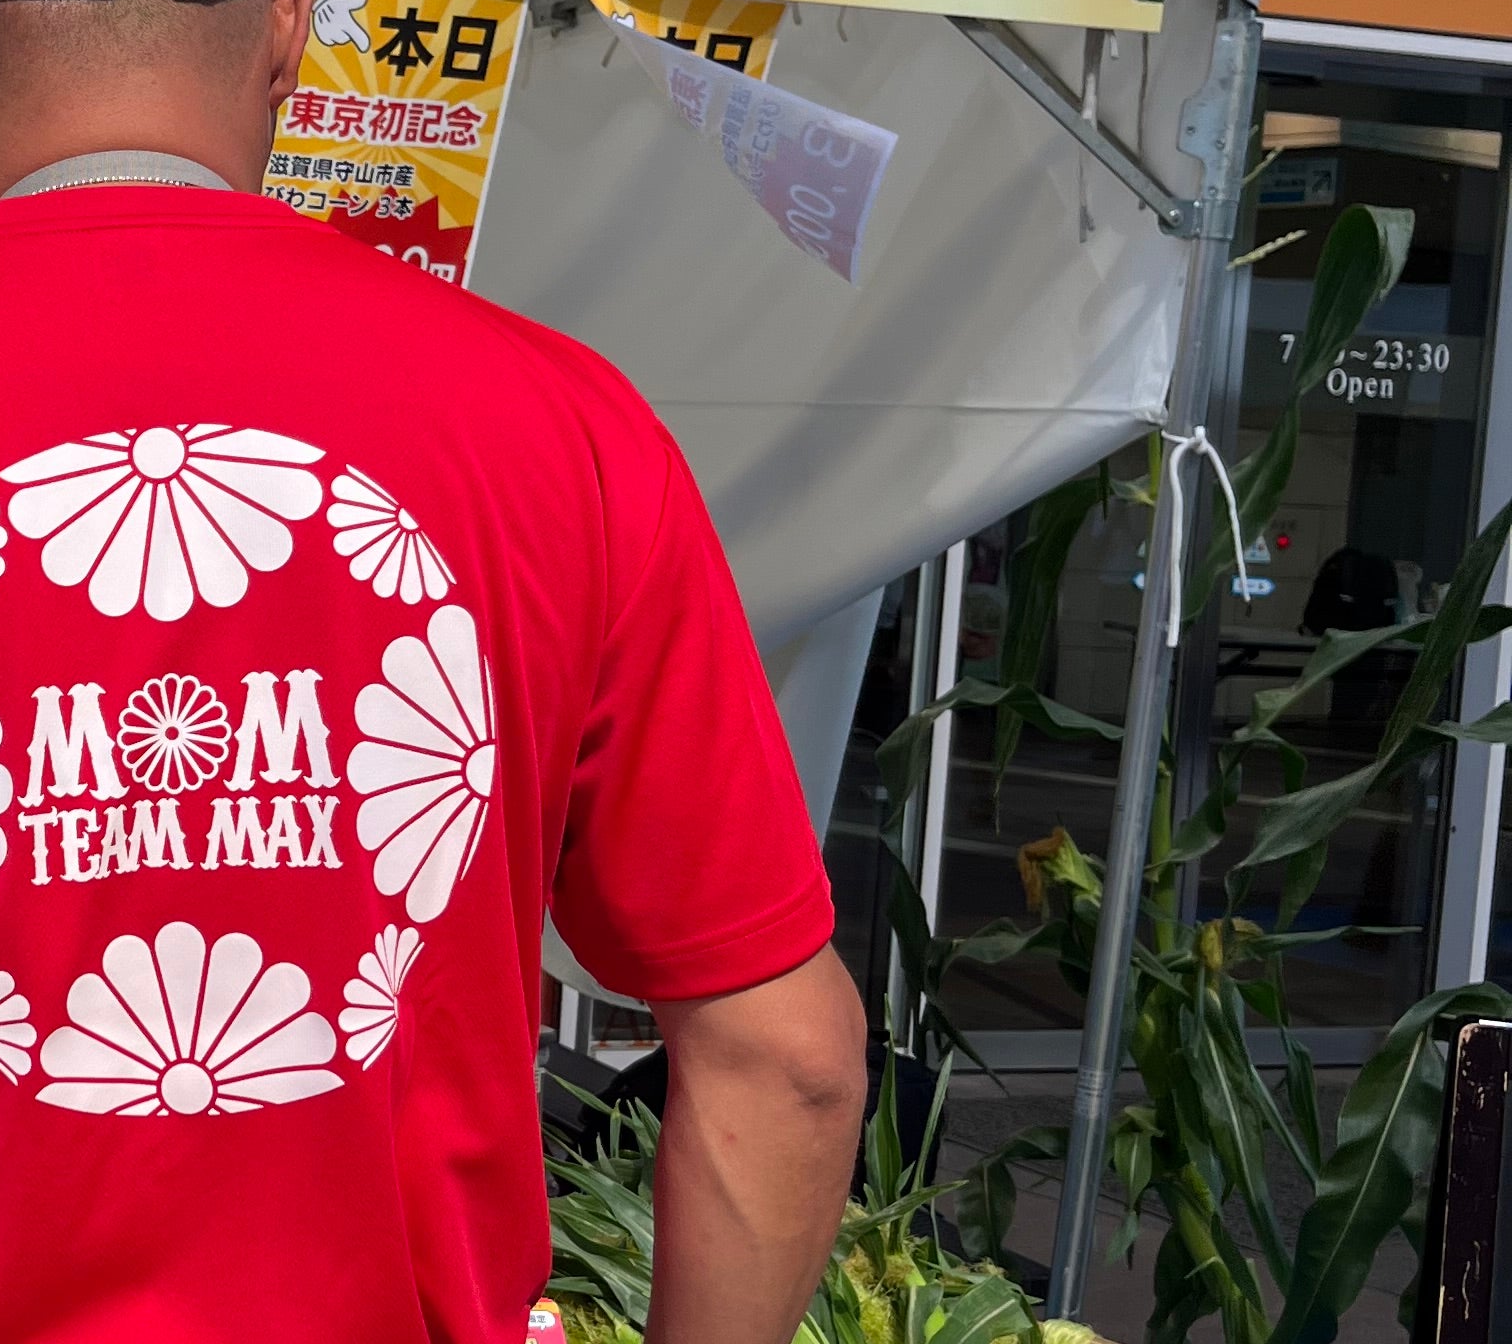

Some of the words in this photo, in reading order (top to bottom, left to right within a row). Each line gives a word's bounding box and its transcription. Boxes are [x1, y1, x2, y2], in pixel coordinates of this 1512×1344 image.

[374, 7, 498, 81] 本日
[285, 90, 482, 147] 東京初記念
[268, 154, 415, 187] 滋賀県守山市産
[1326, 367, 1394, 404] Open
[17, 796, 194, 886] TEAM
[199, 793, 344, 871] MAX
